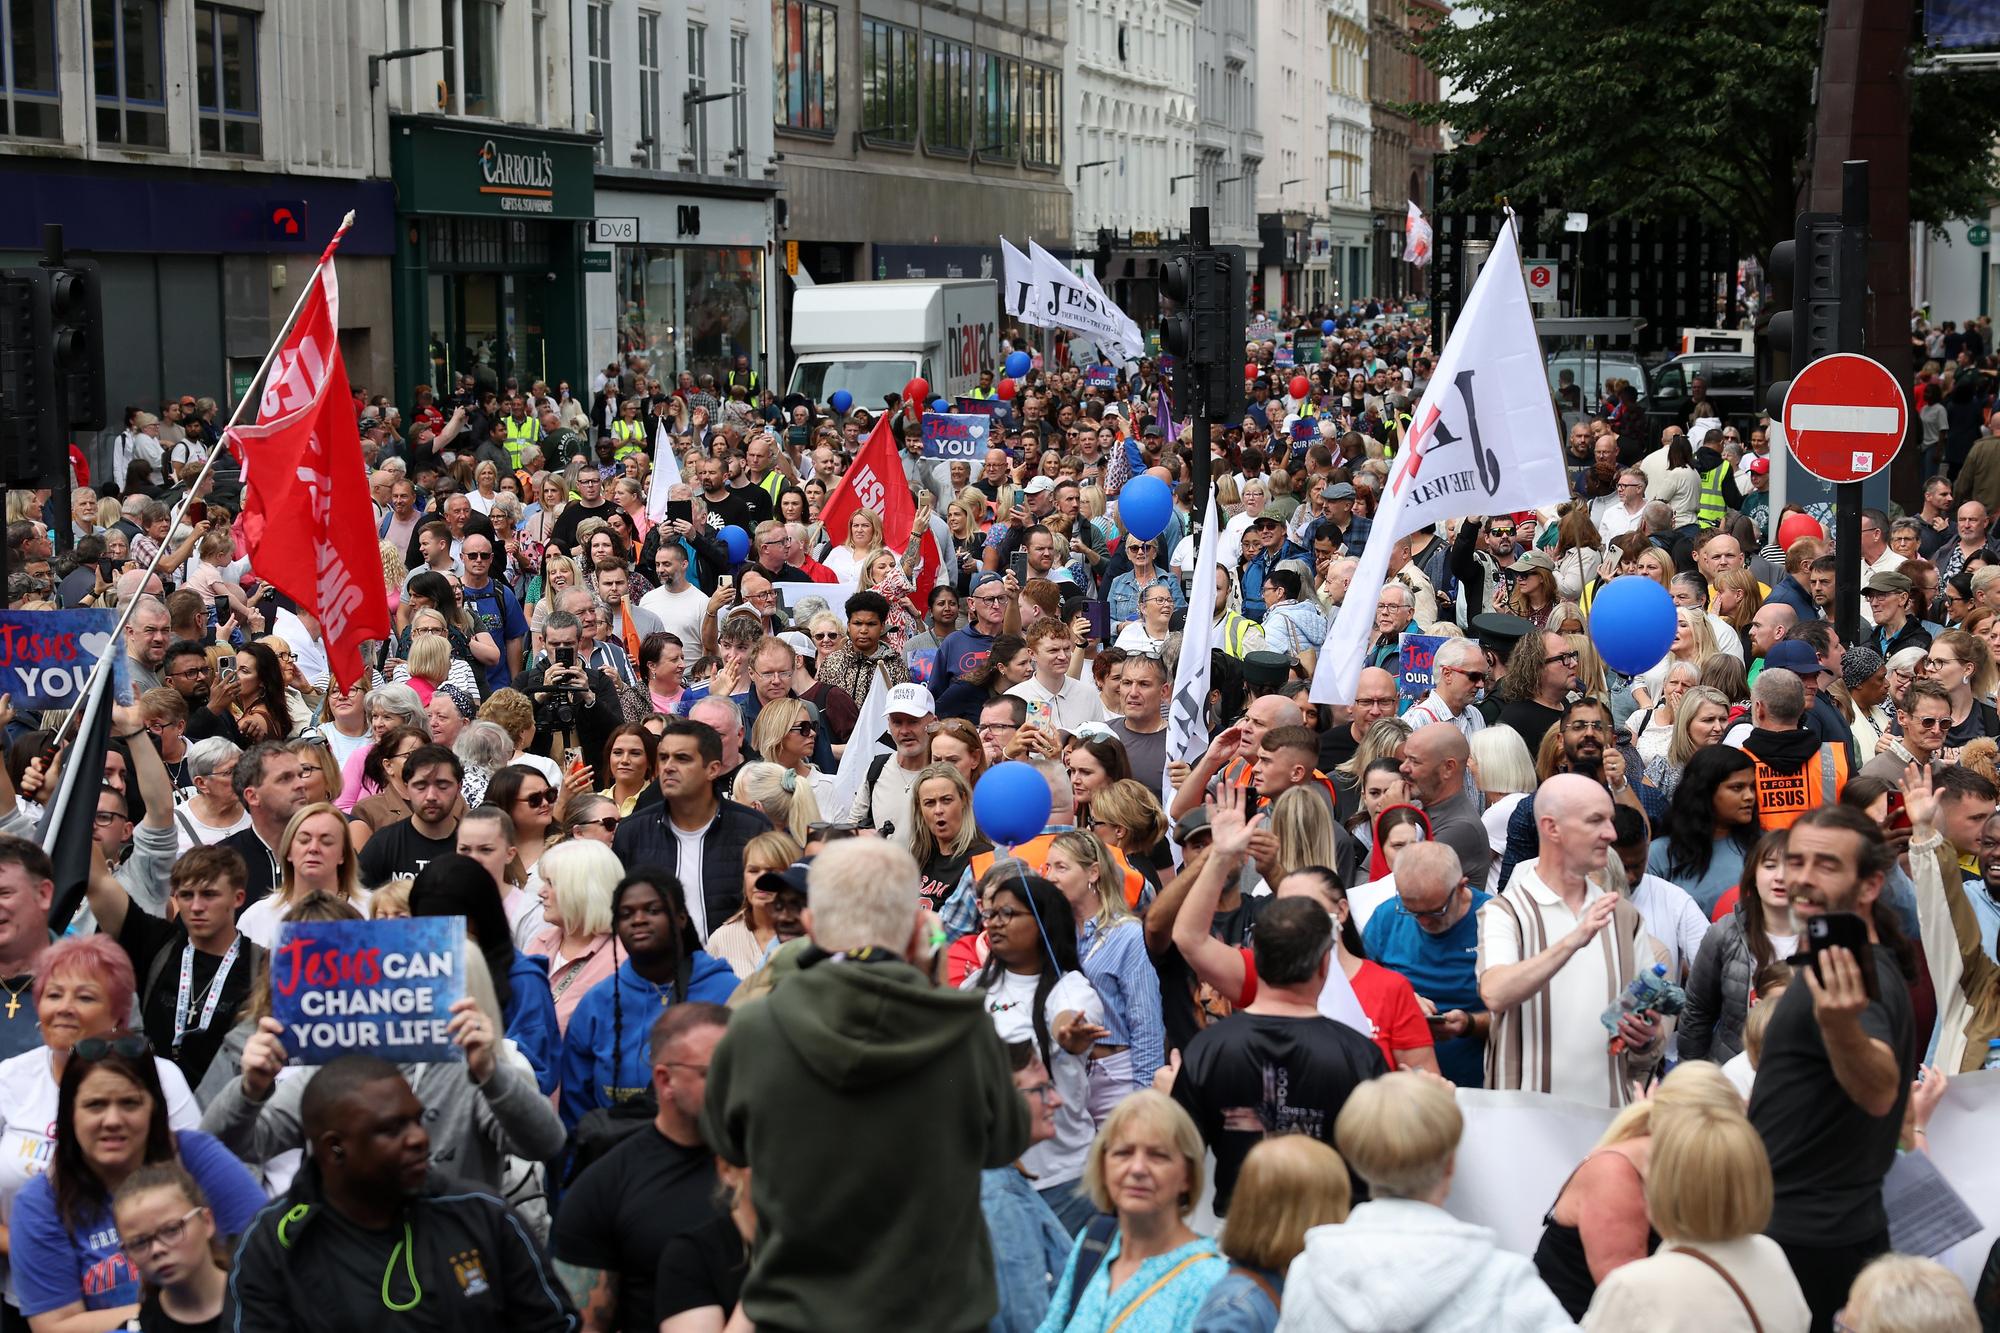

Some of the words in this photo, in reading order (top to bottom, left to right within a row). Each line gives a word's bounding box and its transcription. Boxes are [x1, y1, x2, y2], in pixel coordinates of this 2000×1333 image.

[600, 223, 632, 237] DV8
[1536, 272, 1545, 284] 2
[948, 313, 995, 378] niavac
[1090, 378, 1111, 386] LORD
[927, 419, 969, 440] Jesus
[935, 439, 975, 456] YOU
[1292, 440, 1307, 449] OUR
[0, 623, 77, 667] Jesus
[14, 665, 98, 698] YOU
[1405, 672, 1429, 684] OUR
[1771, 780, 1792, 788] FOR
[1762, 790, 1805, 808] JESUS
[277, 937, 382, 996] Jesus
[382, 951, 453, 979] CAN
[300, 986, 434, 1017] CHANGE
[290, 1021, 381, 1049] YOUR
[385, 1019, 450, 1046] LIFE
